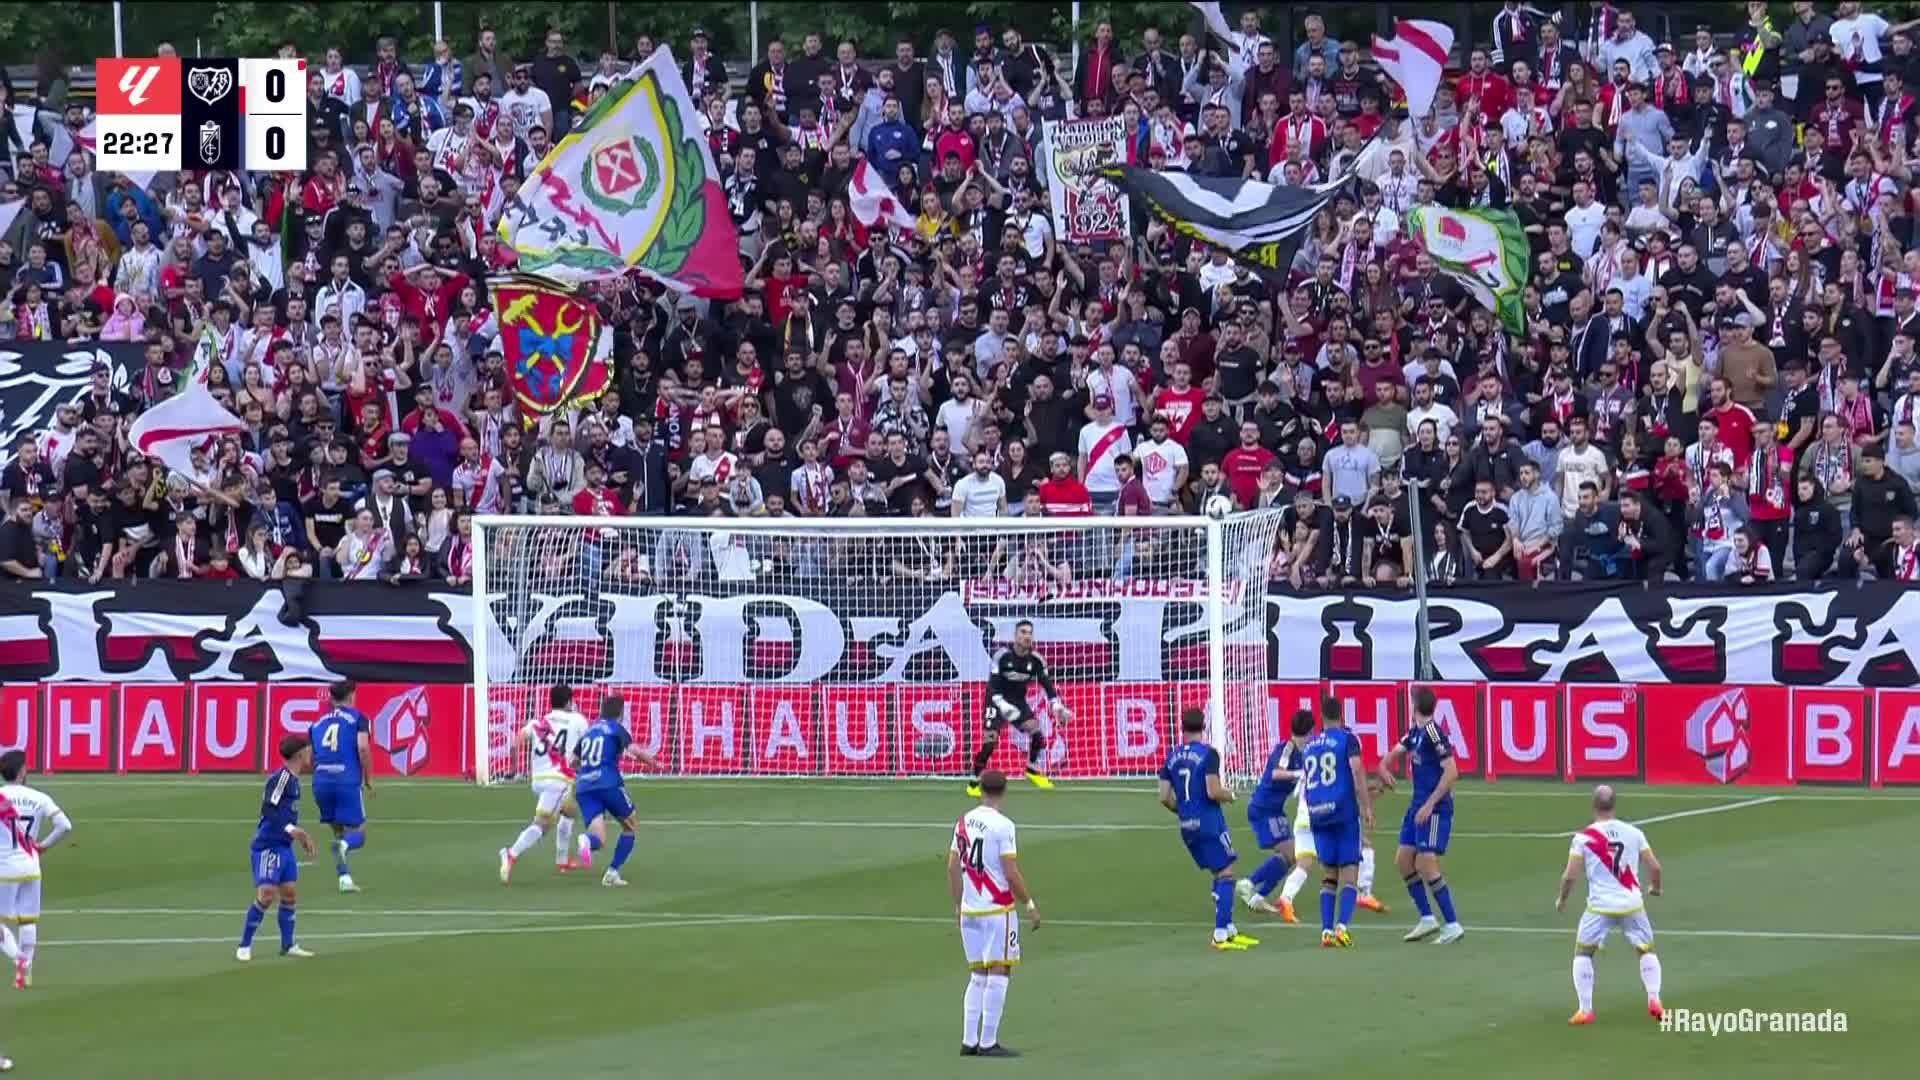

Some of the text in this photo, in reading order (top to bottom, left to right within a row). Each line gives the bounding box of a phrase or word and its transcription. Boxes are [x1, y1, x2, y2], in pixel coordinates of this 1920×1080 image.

[32, 588, 347, 682] LA
[428, 590, 993, 684] VIDA
[321, 723, 340, 752] 4
[487, 698, 956, 761] BUHAUS
[534, 728, 568, 757] 34
[580, 736, 604, 766] 20
[1178, 768, 1191, 801] 7
[1304, 752, 1337, 790] 28
[8, 815, 35, 849] 17
[956, 836, 985, 873] 24
[1605, 841, 1625, 879] 7
